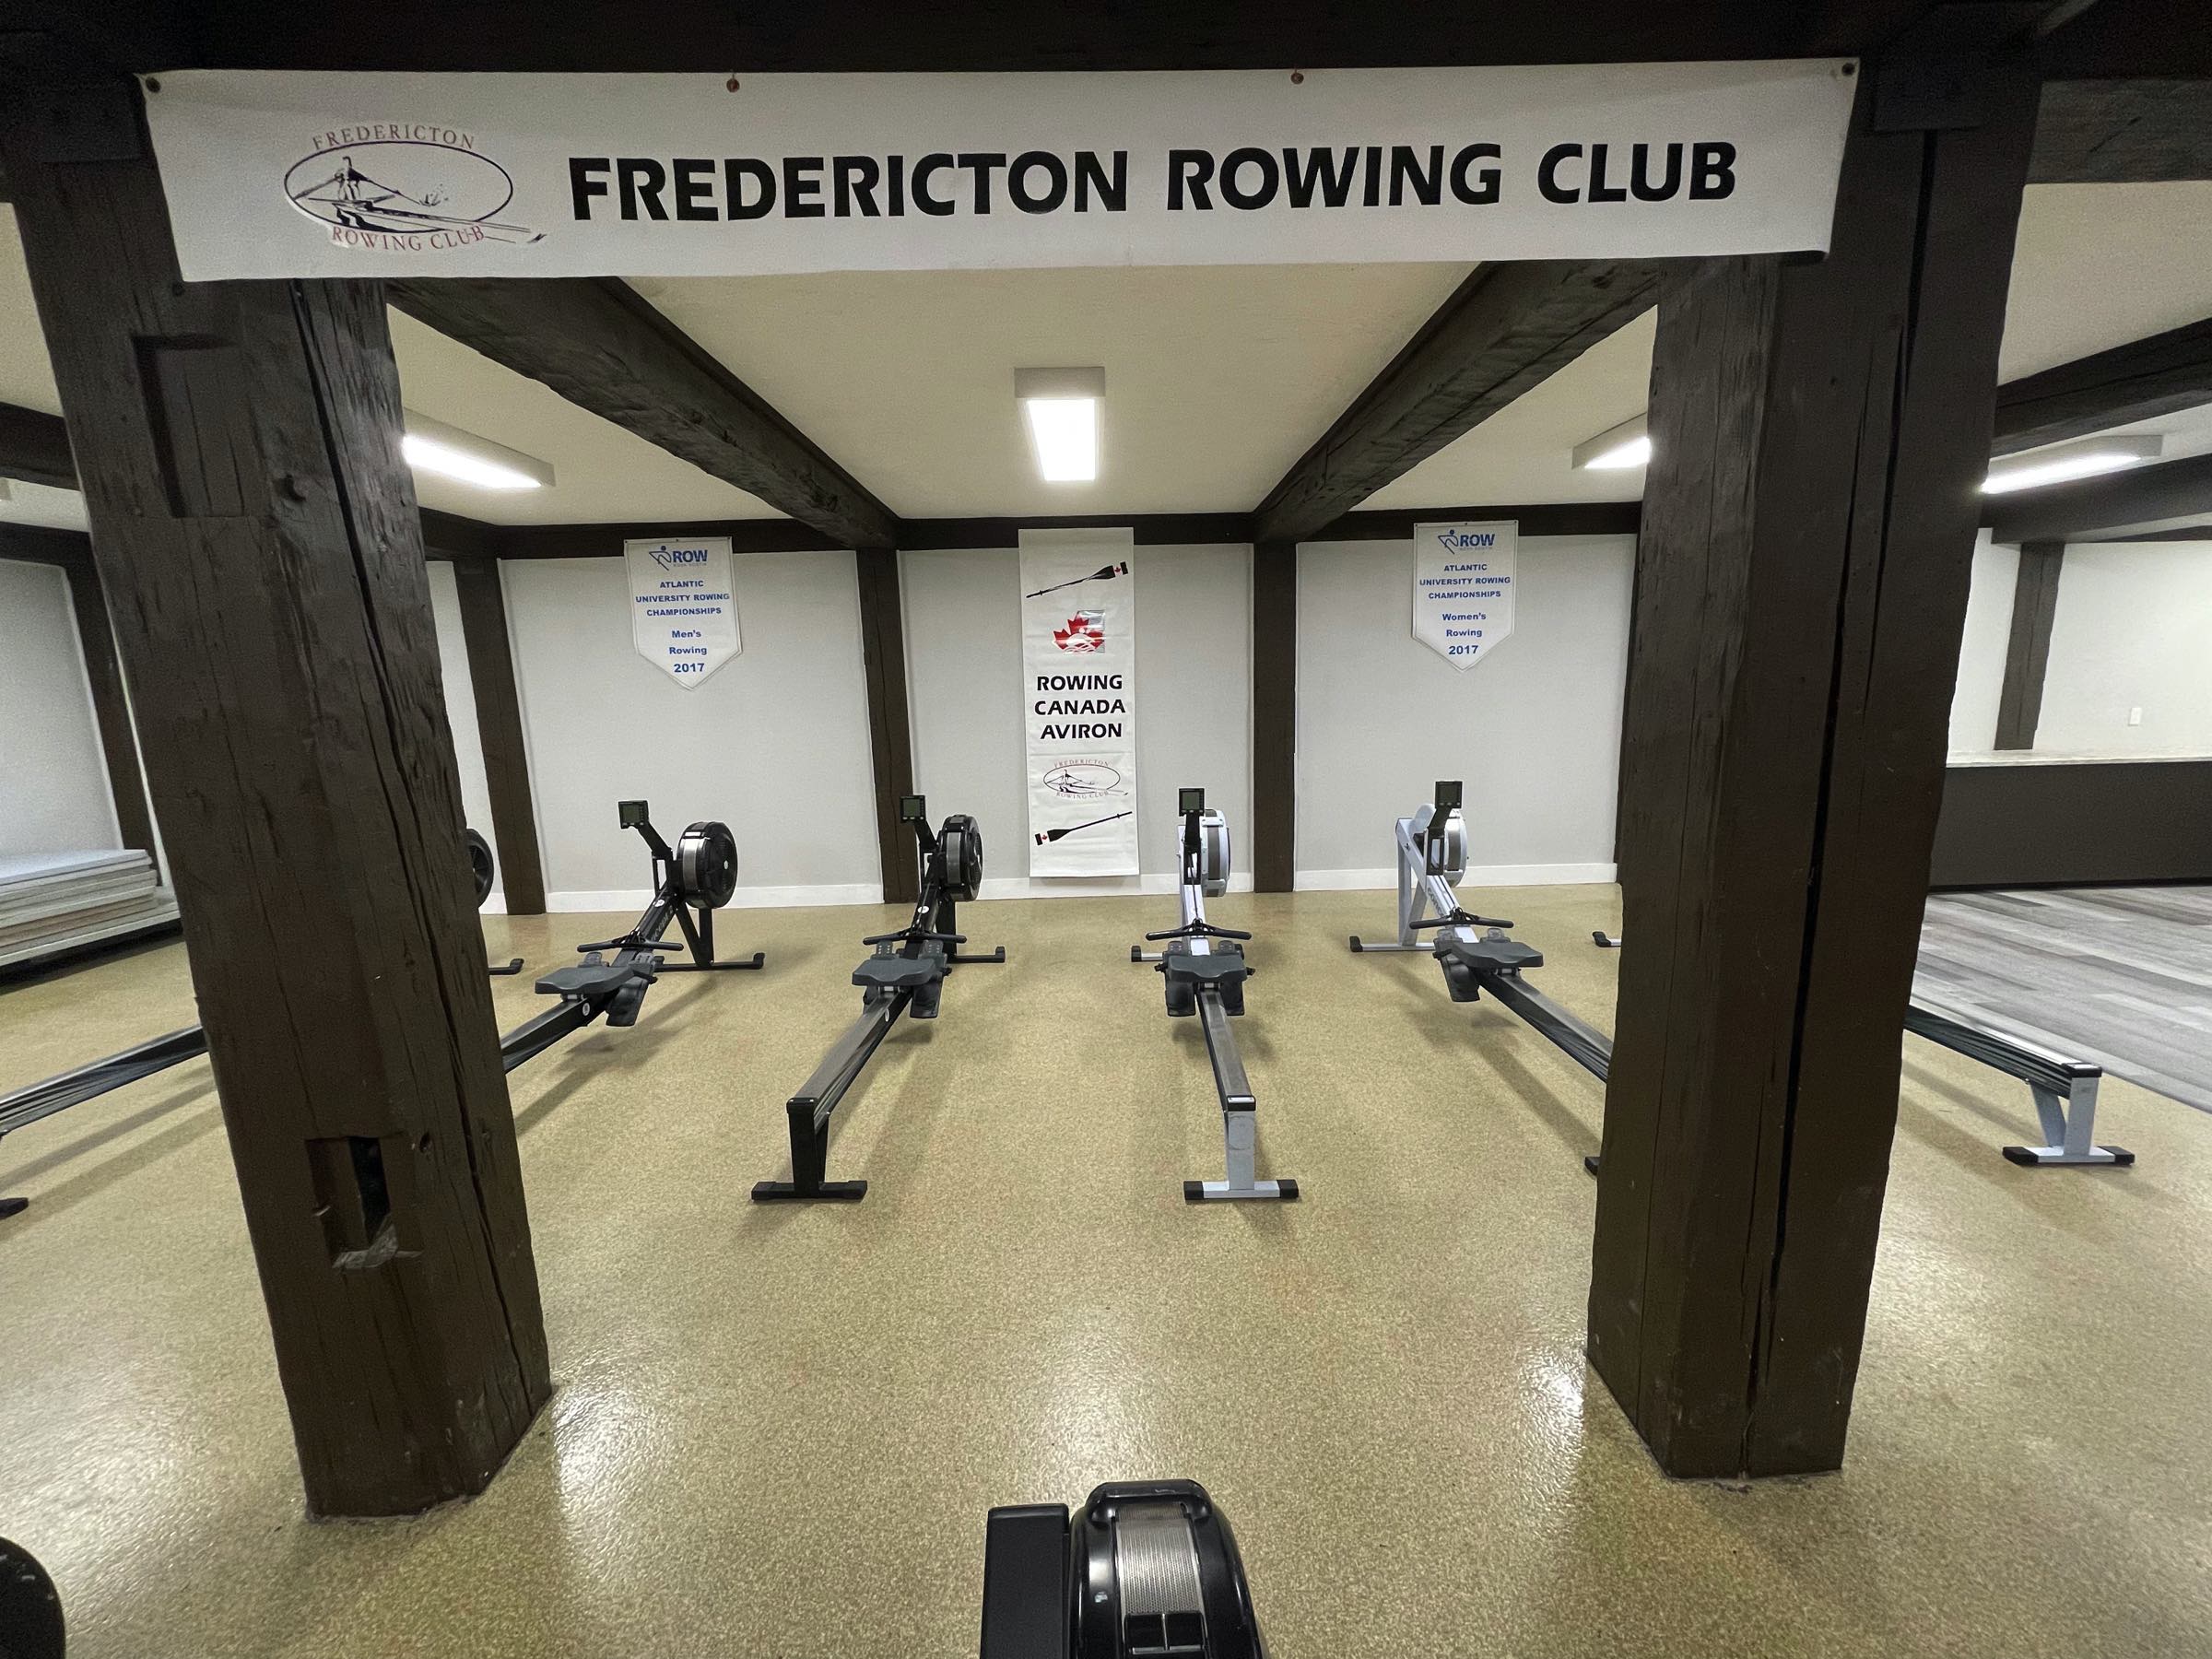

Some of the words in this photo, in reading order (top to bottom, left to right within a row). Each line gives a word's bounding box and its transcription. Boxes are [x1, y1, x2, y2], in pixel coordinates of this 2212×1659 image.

[312, 124, 475, 149] FREDERICTON
[569, 150, 1128, 221] FREDERICTON
[1167, 143, 1502, 211] ROWING
[1537, 141, 1737, 205] CLUB
[332, 226, 422, 251] ROWING
[430, 225, 485, 249] CLUB
[1460, 534, 1496, 547] ROW
[673, 549, 708, 563] ROW
[1444, 563, 1488, 571] ATLANTIC
[660, 580, 704, 588] ATLANTIC
[1419, 578, 1473, 586] UNIVERSITY
[1476, 576, 1511, 584] ROWING
[635, 594, 690, 603] UNIVERSITY
[693, 593, 730, 601] ROWING
[1429, 590, 1501, 599] CHAMPIONSHIPS
[646, 607, 722, 617] CHAMPIONSHIPS
[1441, 612, 1487, 621] Women's
[671, 629, 701, 638] Men's
[1446, 629, 1482, 638] Rowing
[669, 646, 708, 655] Rowing
[1448, 645, 1478, 655] 2017
[674, 663, 704, 673] 2017
[1037, 675, 1123, 691] ROWING
[1034, 699, 1126, 715] CANADA
[1040, 723, 1123, 739] AVIRON
